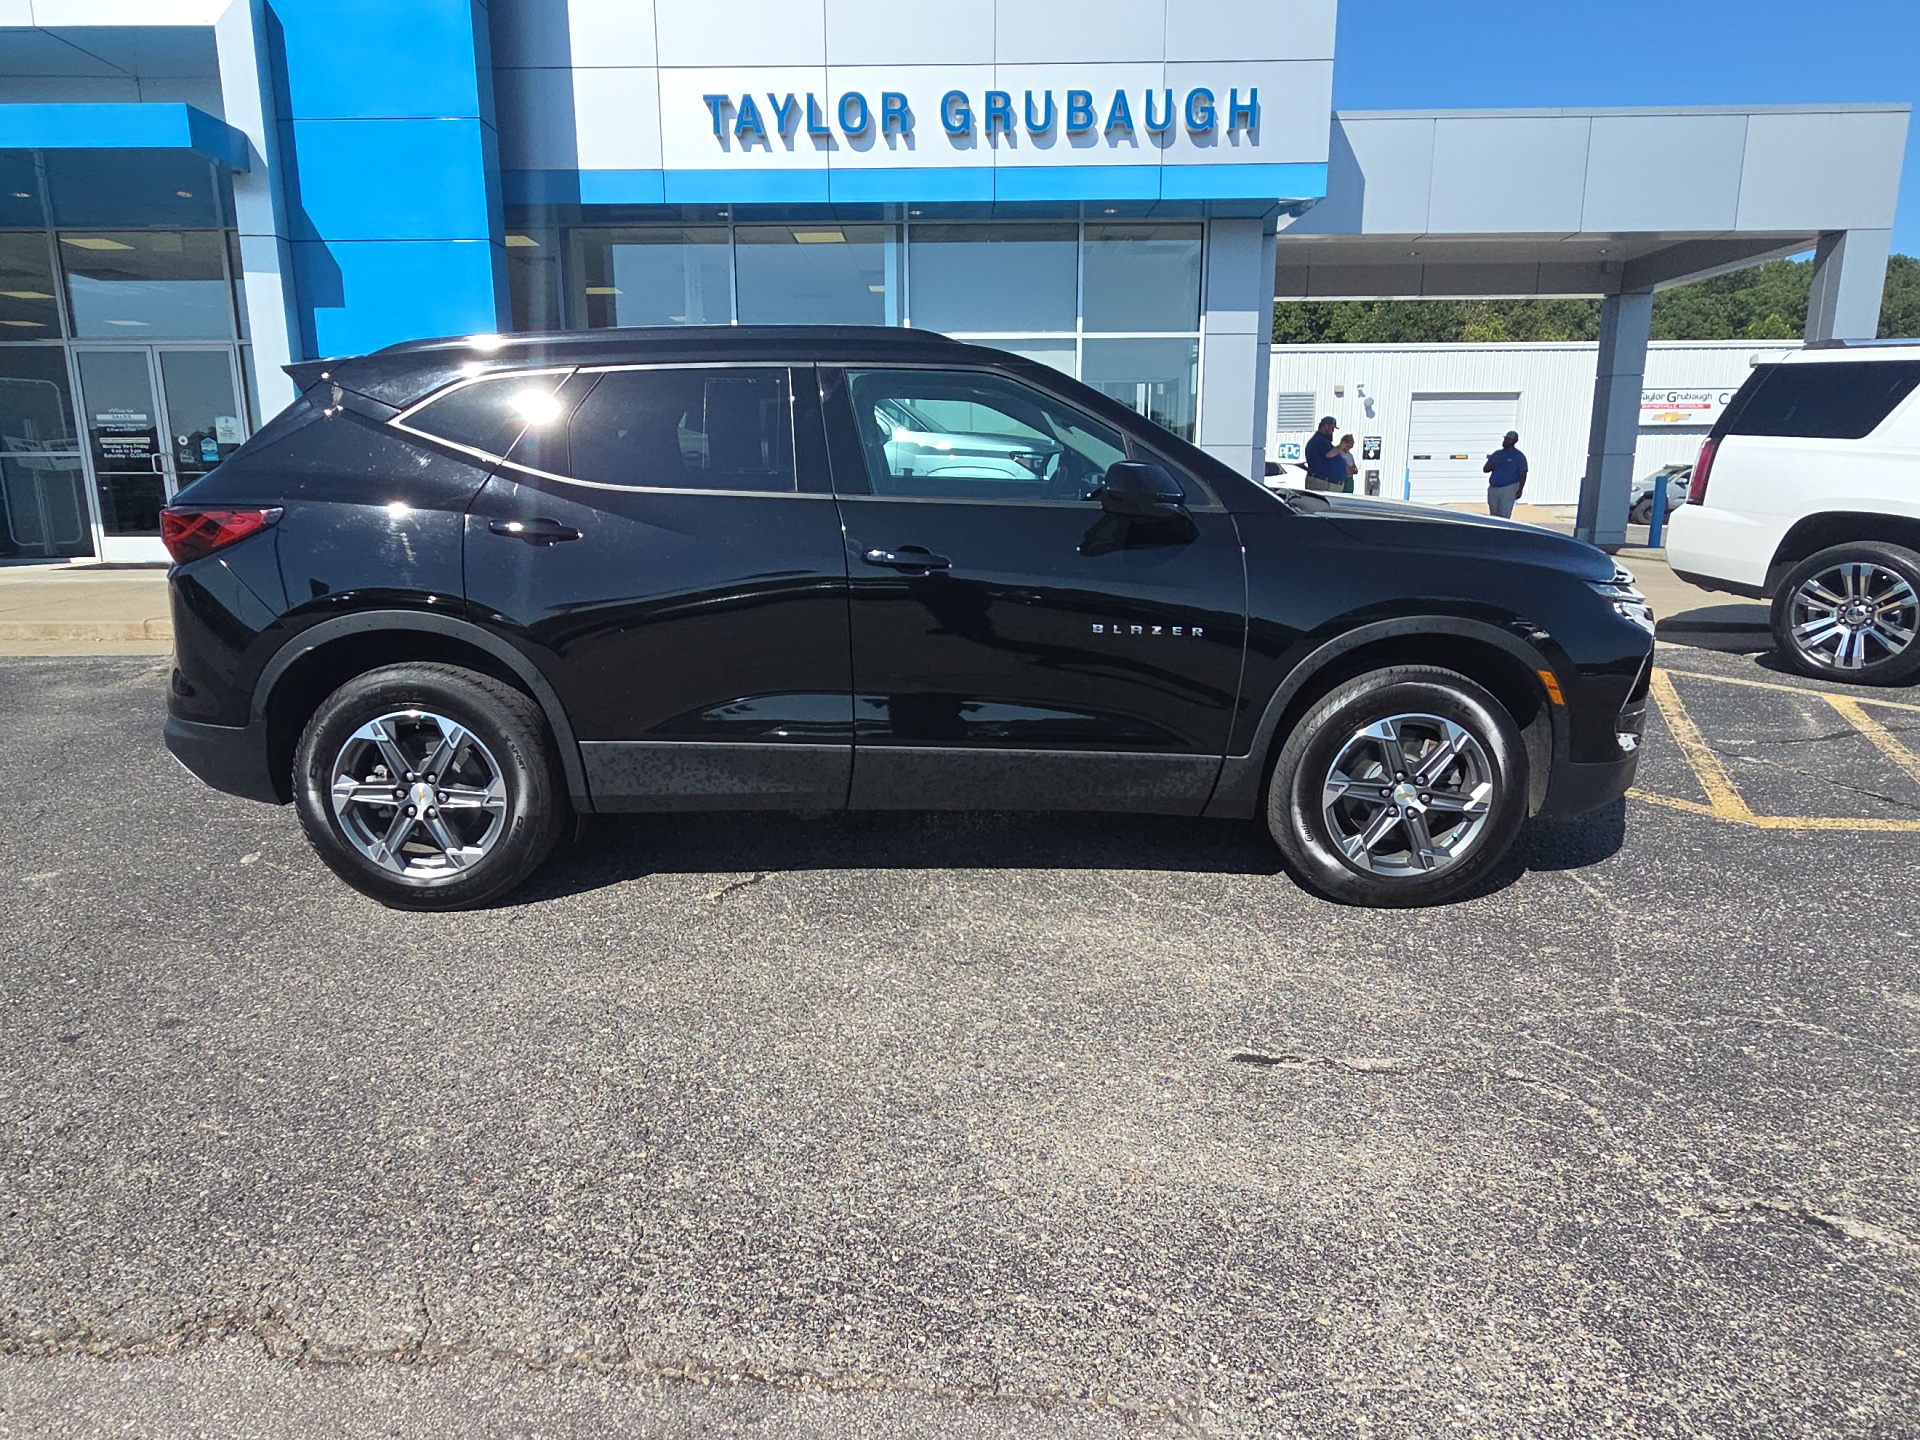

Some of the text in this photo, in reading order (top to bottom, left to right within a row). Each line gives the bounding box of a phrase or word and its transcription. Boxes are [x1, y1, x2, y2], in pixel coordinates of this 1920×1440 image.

[703, 87, 1259, 136] TAYLOR GRUBAUGH
[1667, 391, 1713, 402] Grubaugh
[1279, 444, 1300, 459] PPG
[1092, 623, 1204, 637] BLAZER
